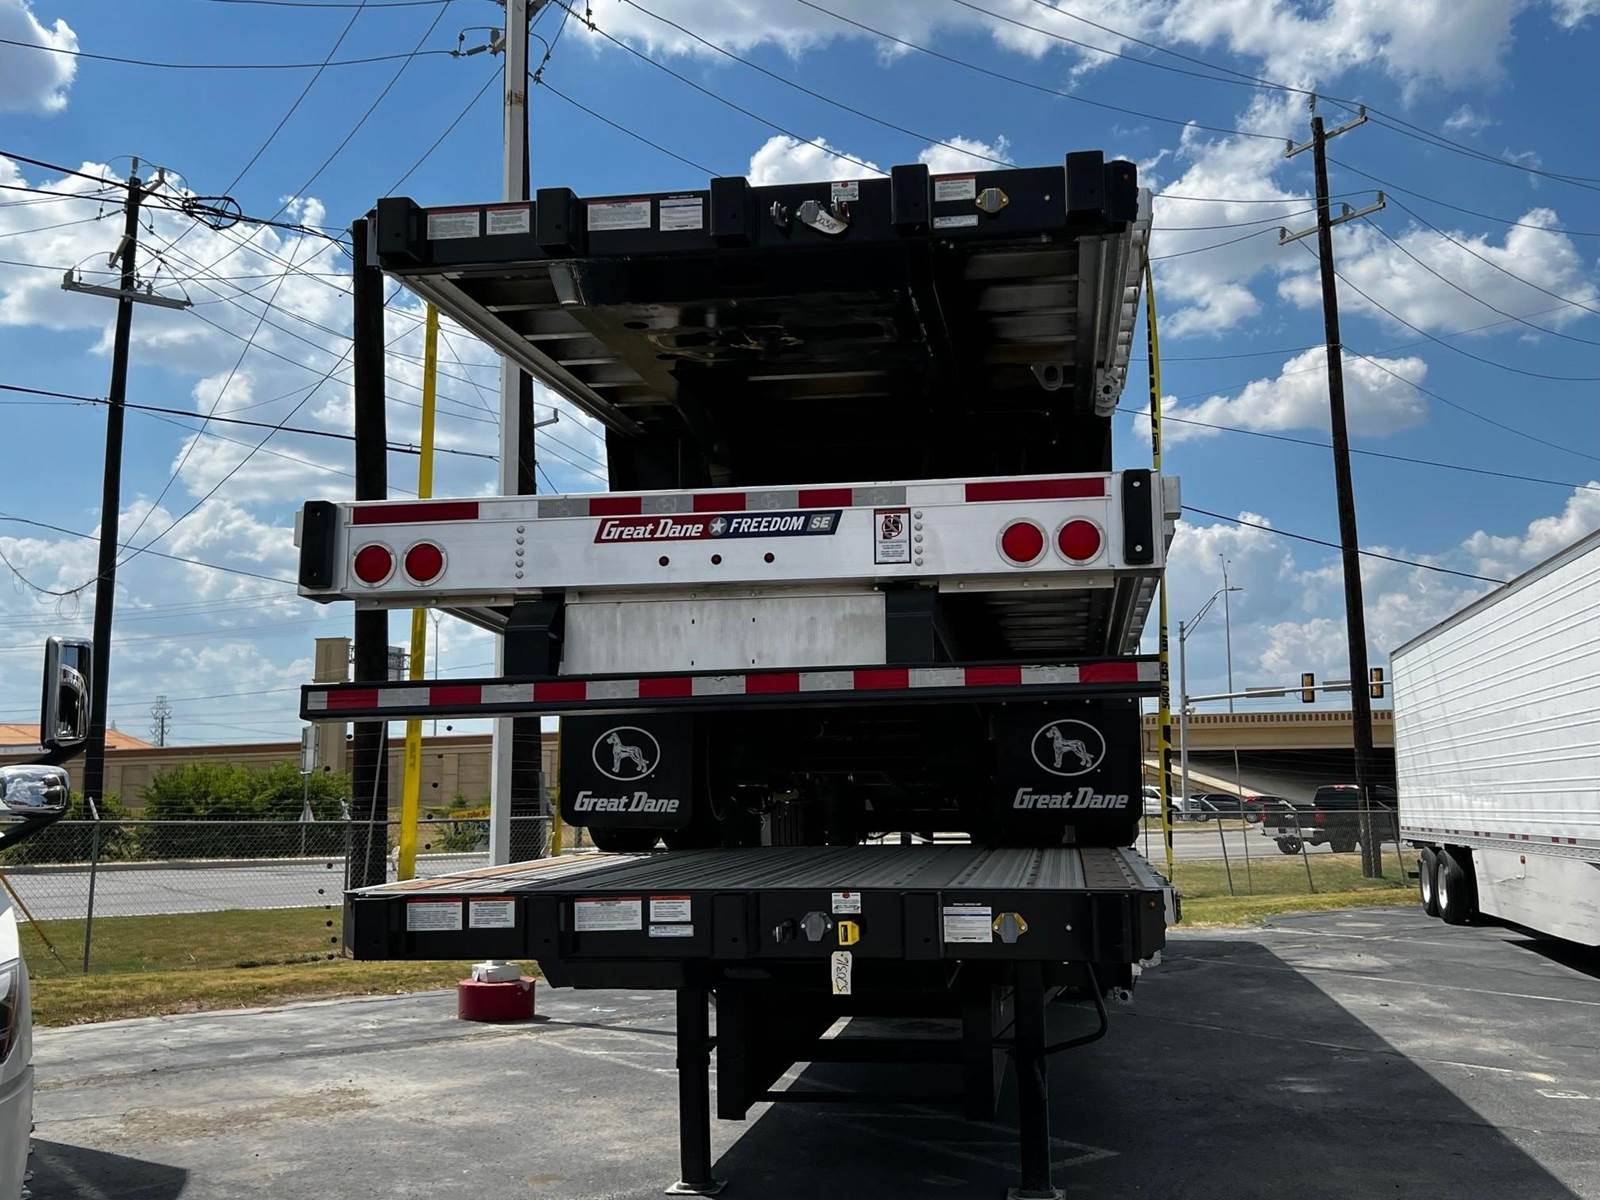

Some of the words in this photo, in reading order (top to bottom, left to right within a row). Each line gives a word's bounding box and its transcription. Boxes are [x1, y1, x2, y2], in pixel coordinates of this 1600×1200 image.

[601, 520, 655, 540] Great
[653, 518, 704, 538] Dane
[729, 515, 806, 533] FREEDOM
[810, 516, 832, 529] SE
[574, 790, 630, 812] Great
[627, 791, 680, 813] Dane
[1012, 787, 1073, 809] Great
[1072, 786, 1129, 809] Dane
